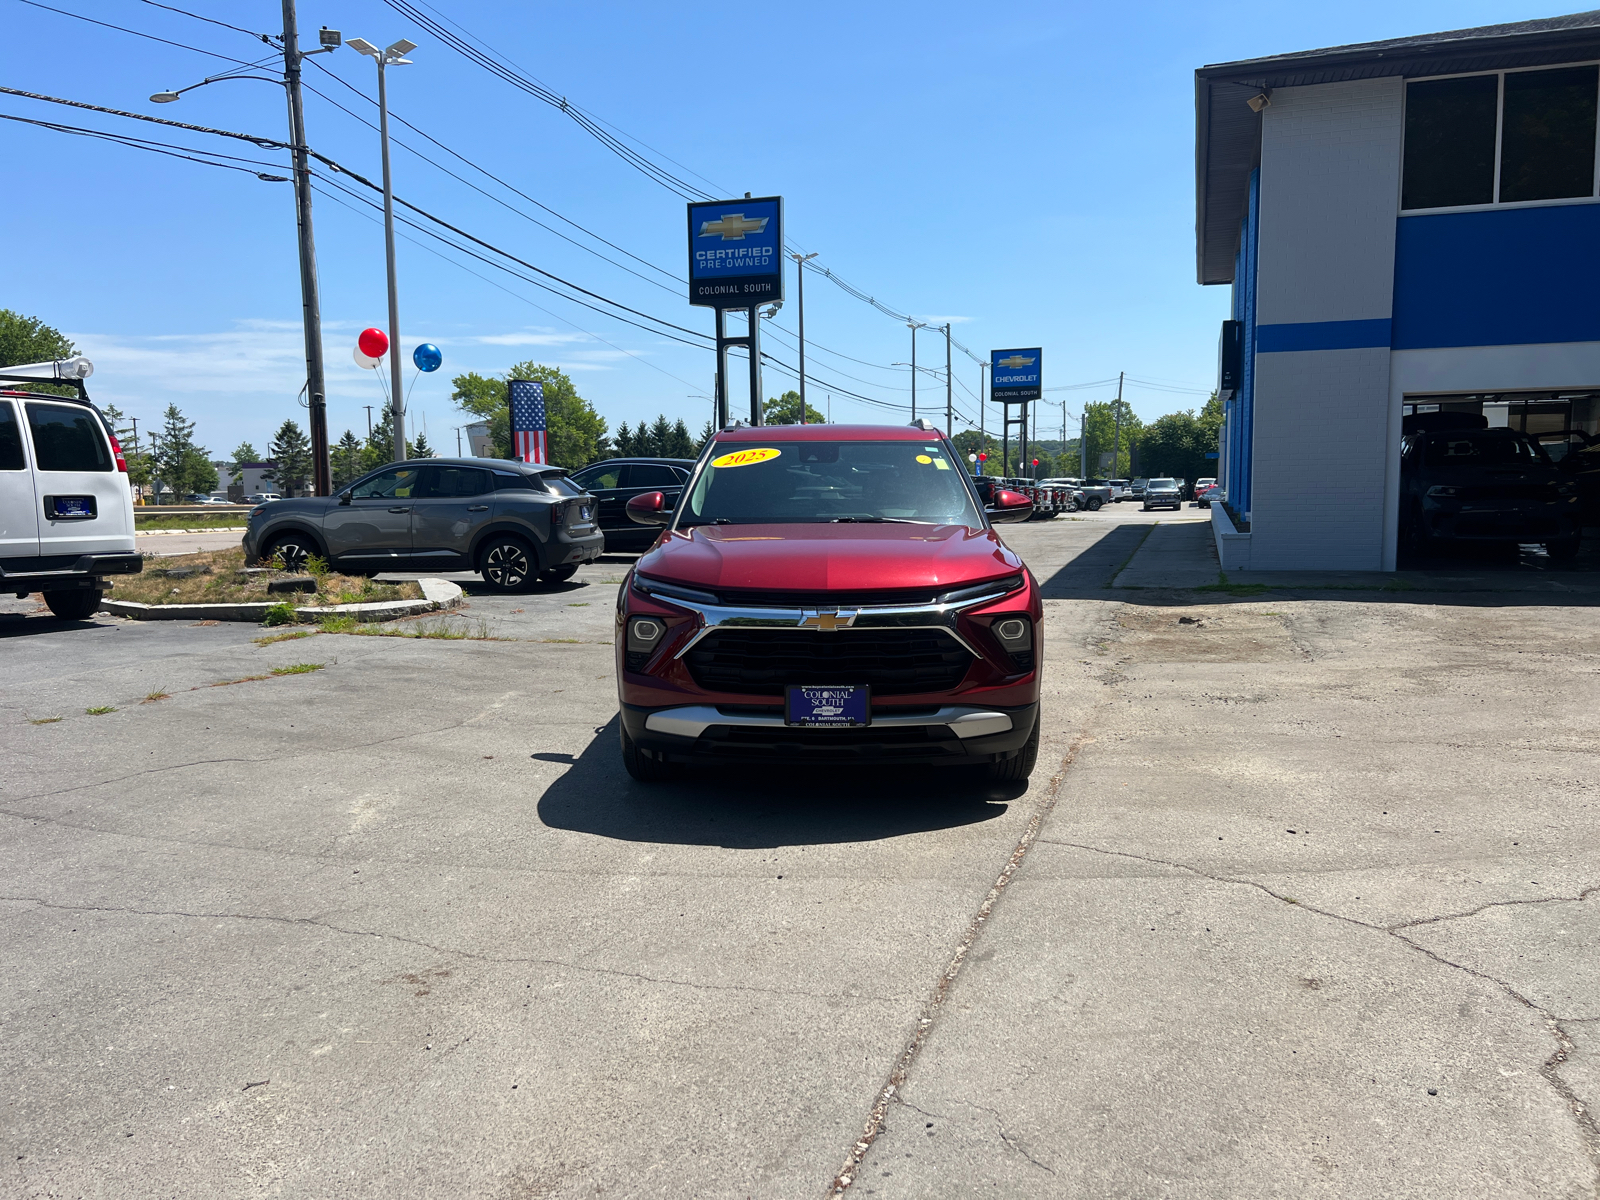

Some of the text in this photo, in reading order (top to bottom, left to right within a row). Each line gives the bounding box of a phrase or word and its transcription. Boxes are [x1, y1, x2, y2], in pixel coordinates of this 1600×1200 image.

[696, 247, 773, 260] CERTIFIED
[700, 257, 769, 269] PRE-OWNED
[699, 283, 771, 295] COLONIAL SOUTH
[995, 375, 1037, 383] CHEVROLET
[722, 450, 768, 466] 2025
[804, 691, 852, 699] COLONIAL
